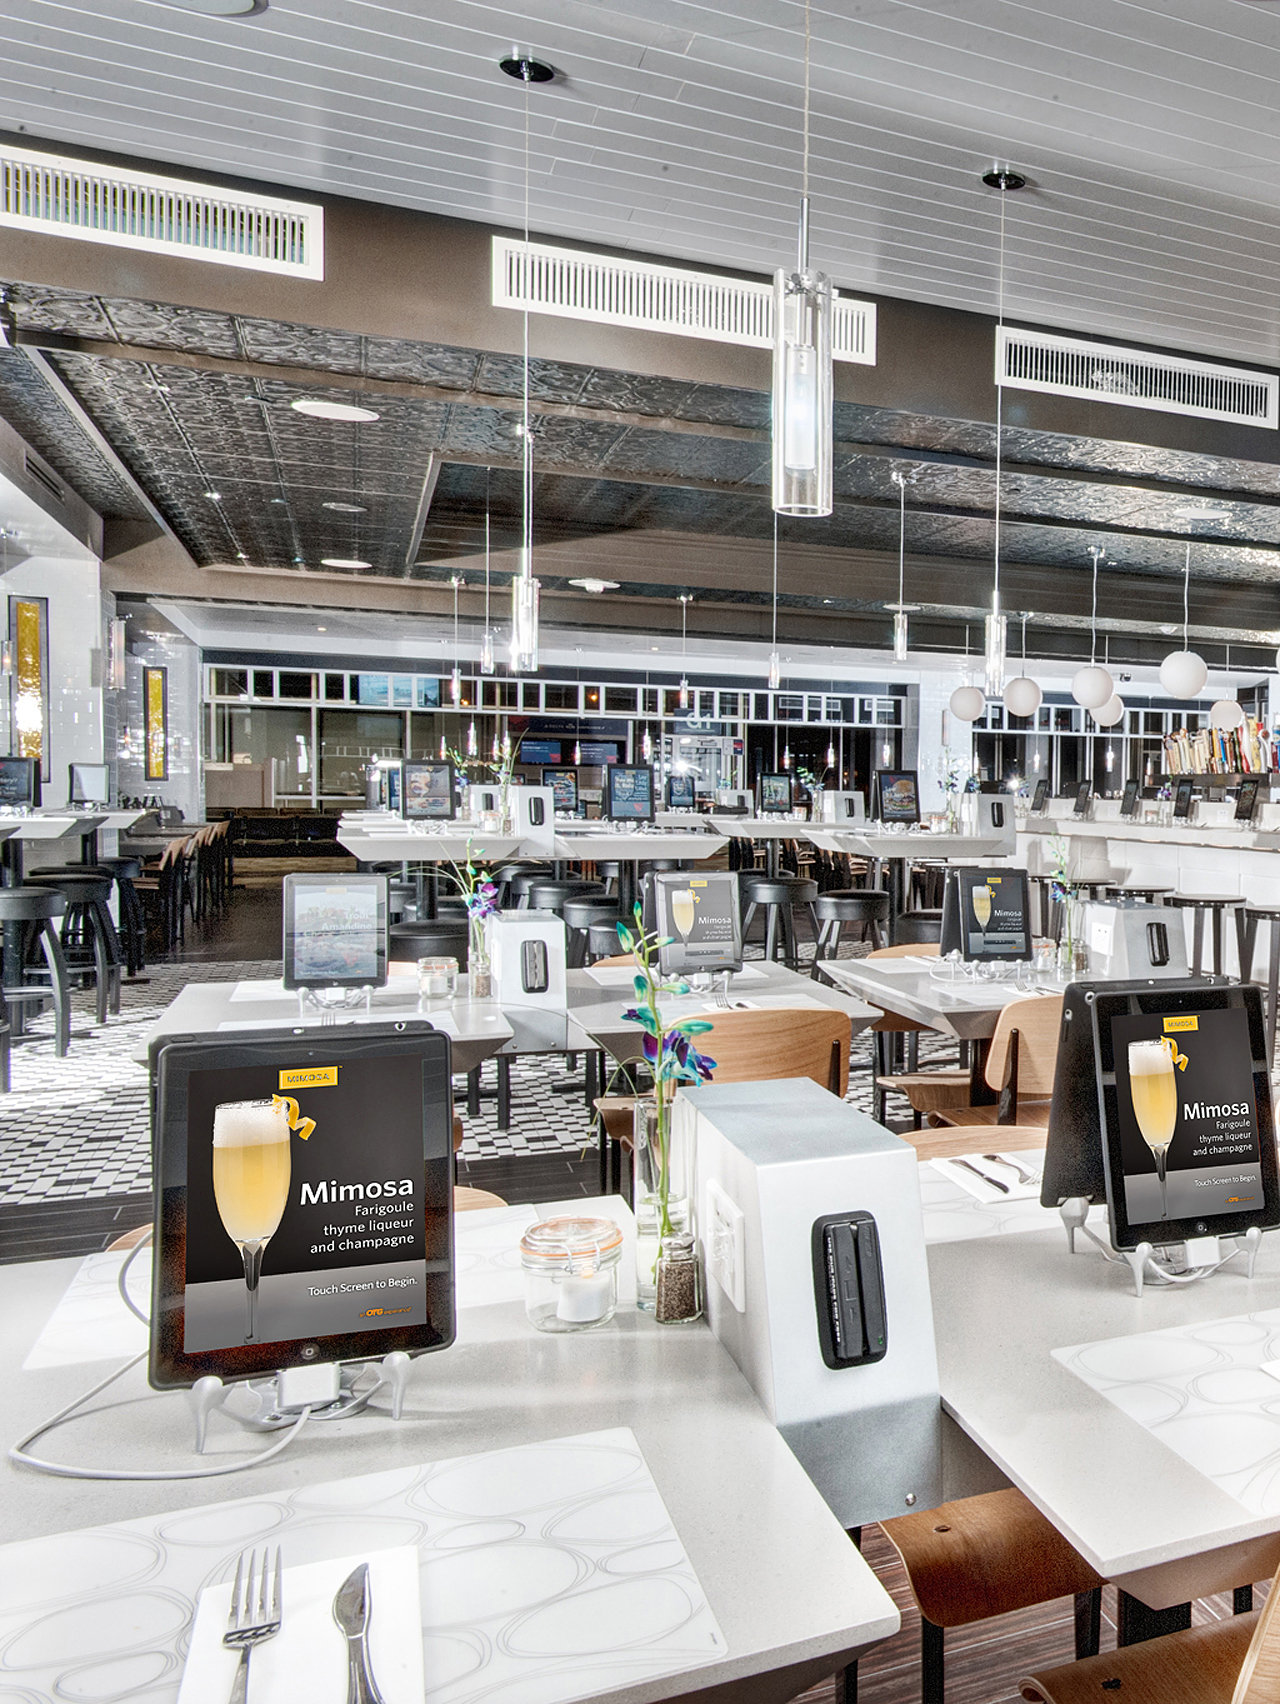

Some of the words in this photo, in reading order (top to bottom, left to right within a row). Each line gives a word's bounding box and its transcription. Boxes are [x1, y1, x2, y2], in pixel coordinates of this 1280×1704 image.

[994, 909, 1022, 917] Mimosa
[698, 916, 732, 925] Mimosa
[1168, 1020, 1194, 1028] MIMOSA
[287, 1072, 330, 1084] MIMOSA
[1183, 1101, 1250, 1121] Mimosa
[1216, 1119, 1250, 1131] Farigoule
[1199, 1134, 1224, 1145] thyme
[1225, 1131, 1251, 1143] liqueur
[1192, 1146, 1207, 1156] and
[1208, 1143, 1253, 1156] champagne
[300, 1178, 414, 1206] Mimosa
[355, 1200, 414, 1218] Farigoule
[323, 1221, 365, 1238] thyme
[369, 1217, 414, 1235] liqueur
[310, 1240, 335, 1254] and
[338, 1233, 415, 1254] champagne
[308, 1284, 338, 1296] Touch
[340, 1281, 374, 1293] Screen
[375, 1279, 386, 1289] to
[388, 1276, 418, 1288] Begin.
